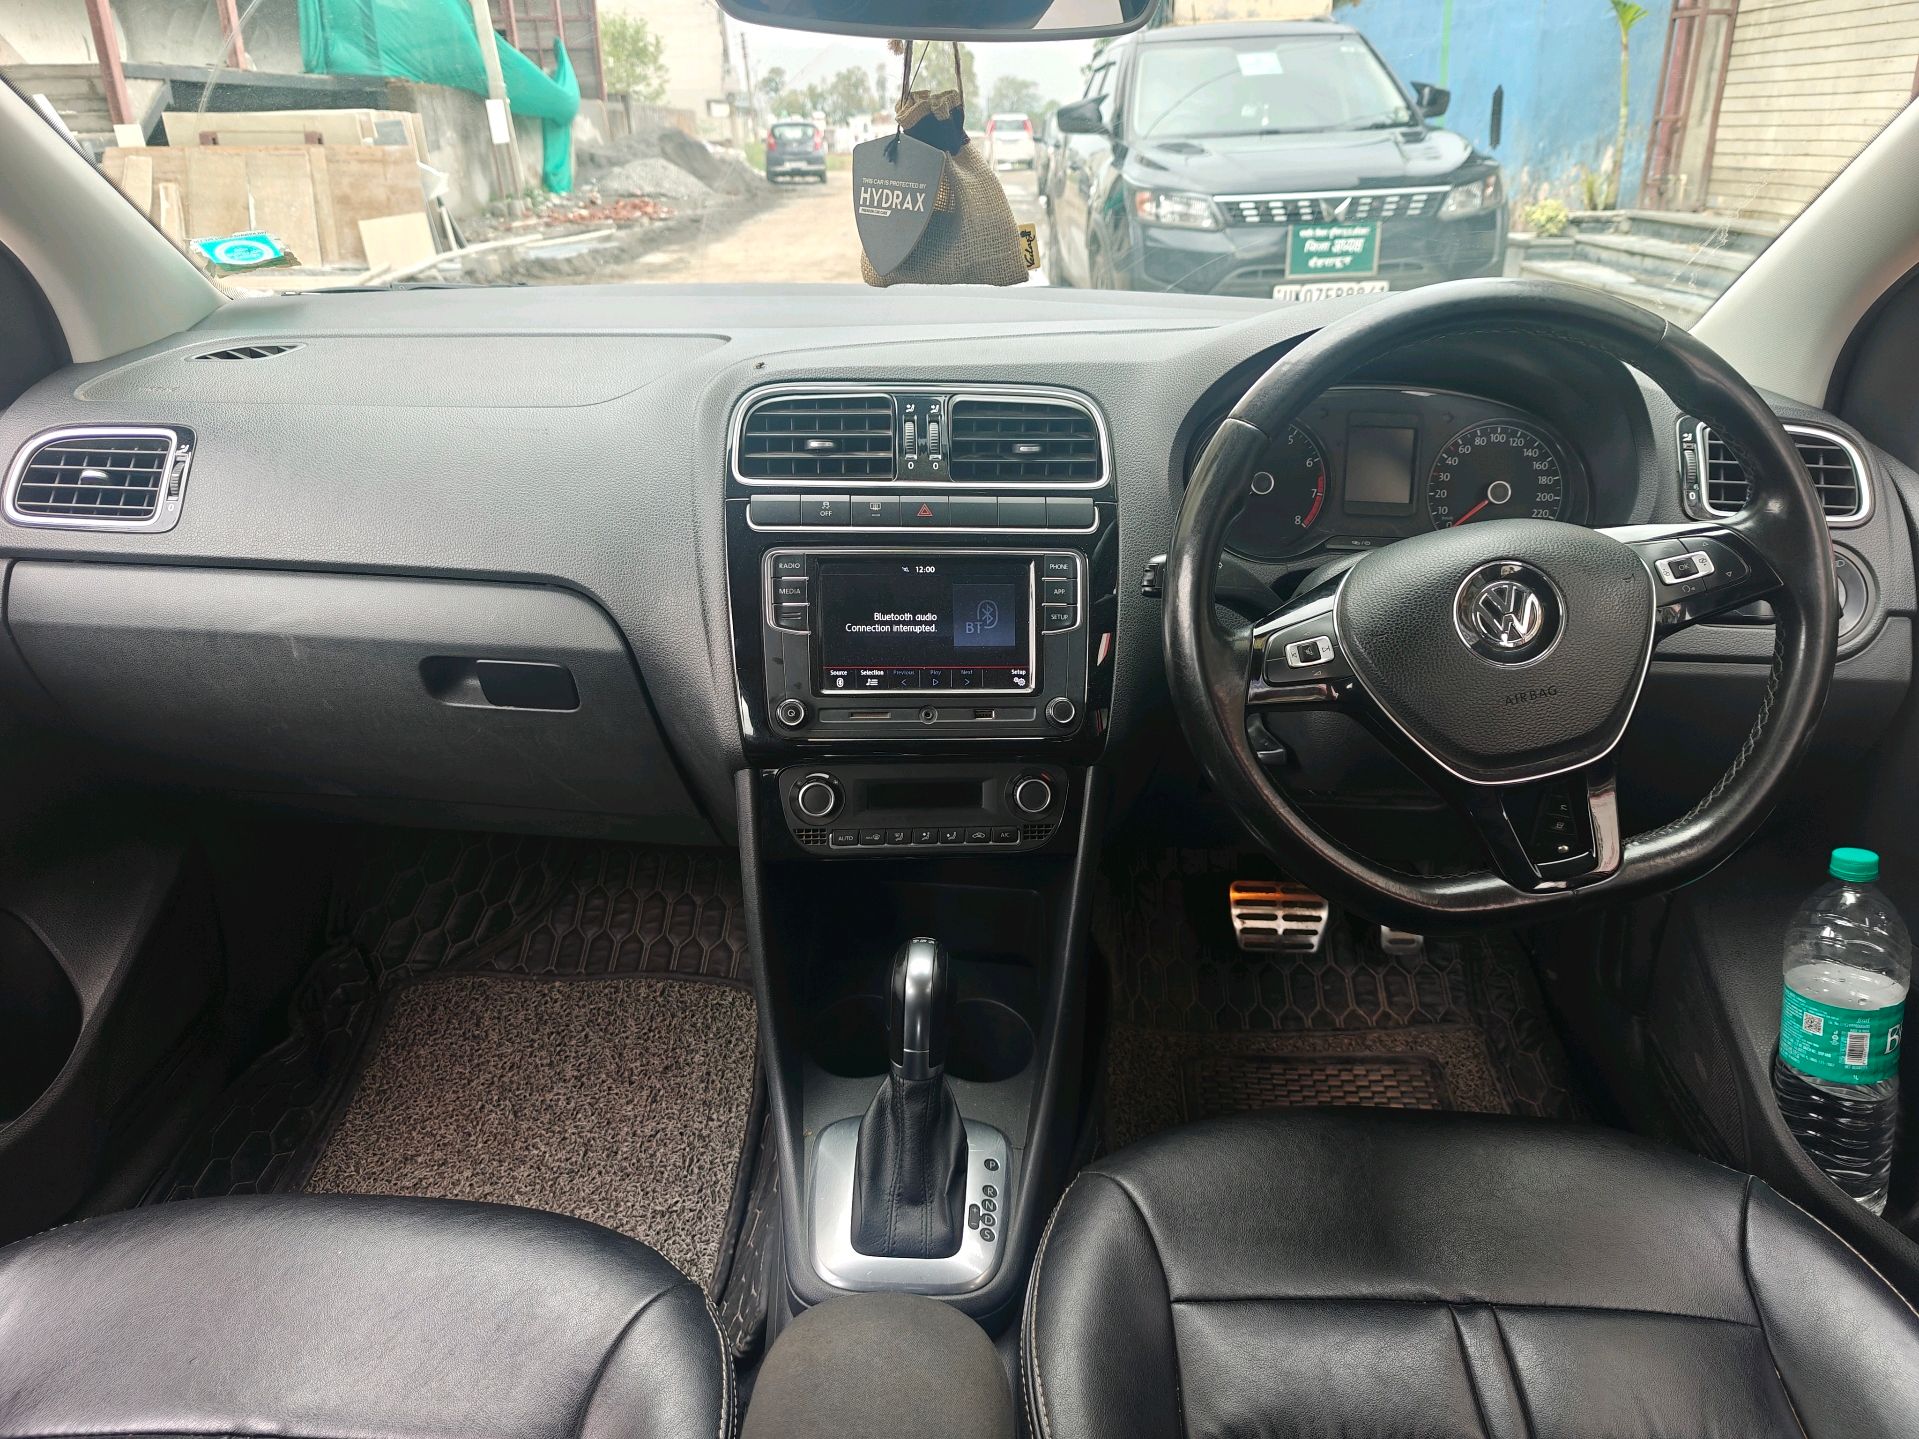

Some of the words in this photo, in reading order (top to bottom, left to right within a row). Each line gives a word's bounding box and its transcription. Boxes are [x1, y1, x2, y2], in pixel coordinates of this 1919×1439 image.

[890, 181, 919, 189] PROTECTED
[860, 187, 926, 212] HYDRAX
[1288, 435, 1293, 444] 5
[1474, 437, 1486, 446] 80
[1490, 434, 1506, 443] 100
[1510, 438, 1524, 447] 120
[1458, 445, 1471, 454] 60
[1523, 448, 1539, 458] 140
[908, 461, 914, 469] 0
[1306, 458, 1313, 468] 6
[1446, 457, 1458, 465] 40
[1533, 462, 1549, 470] 160
[1439, 473, 1450, 481] 30
[1538, 476, 1553, 484] 180
[1311, 489, 1317, 498] 7
[1435, 490, 1447, 498] 20
[1536, 492, 1553, 501] 200
[1532, 509, 1549, 518] 220
[1294, 515, 1301, 525] 8
[1678, 561, 1690, 571] OK
[874, 612, 913, 621] Bluetooth
[916, 612, 937, 621] audio
[845, 623, 889, 632] Connection
[892, 623, 938, 634] interrupted.
[966, 622, 983, 634] BT
[1506, 686, 1557, 706] AIRBAG
[984, 1231, 990, 1239] S
